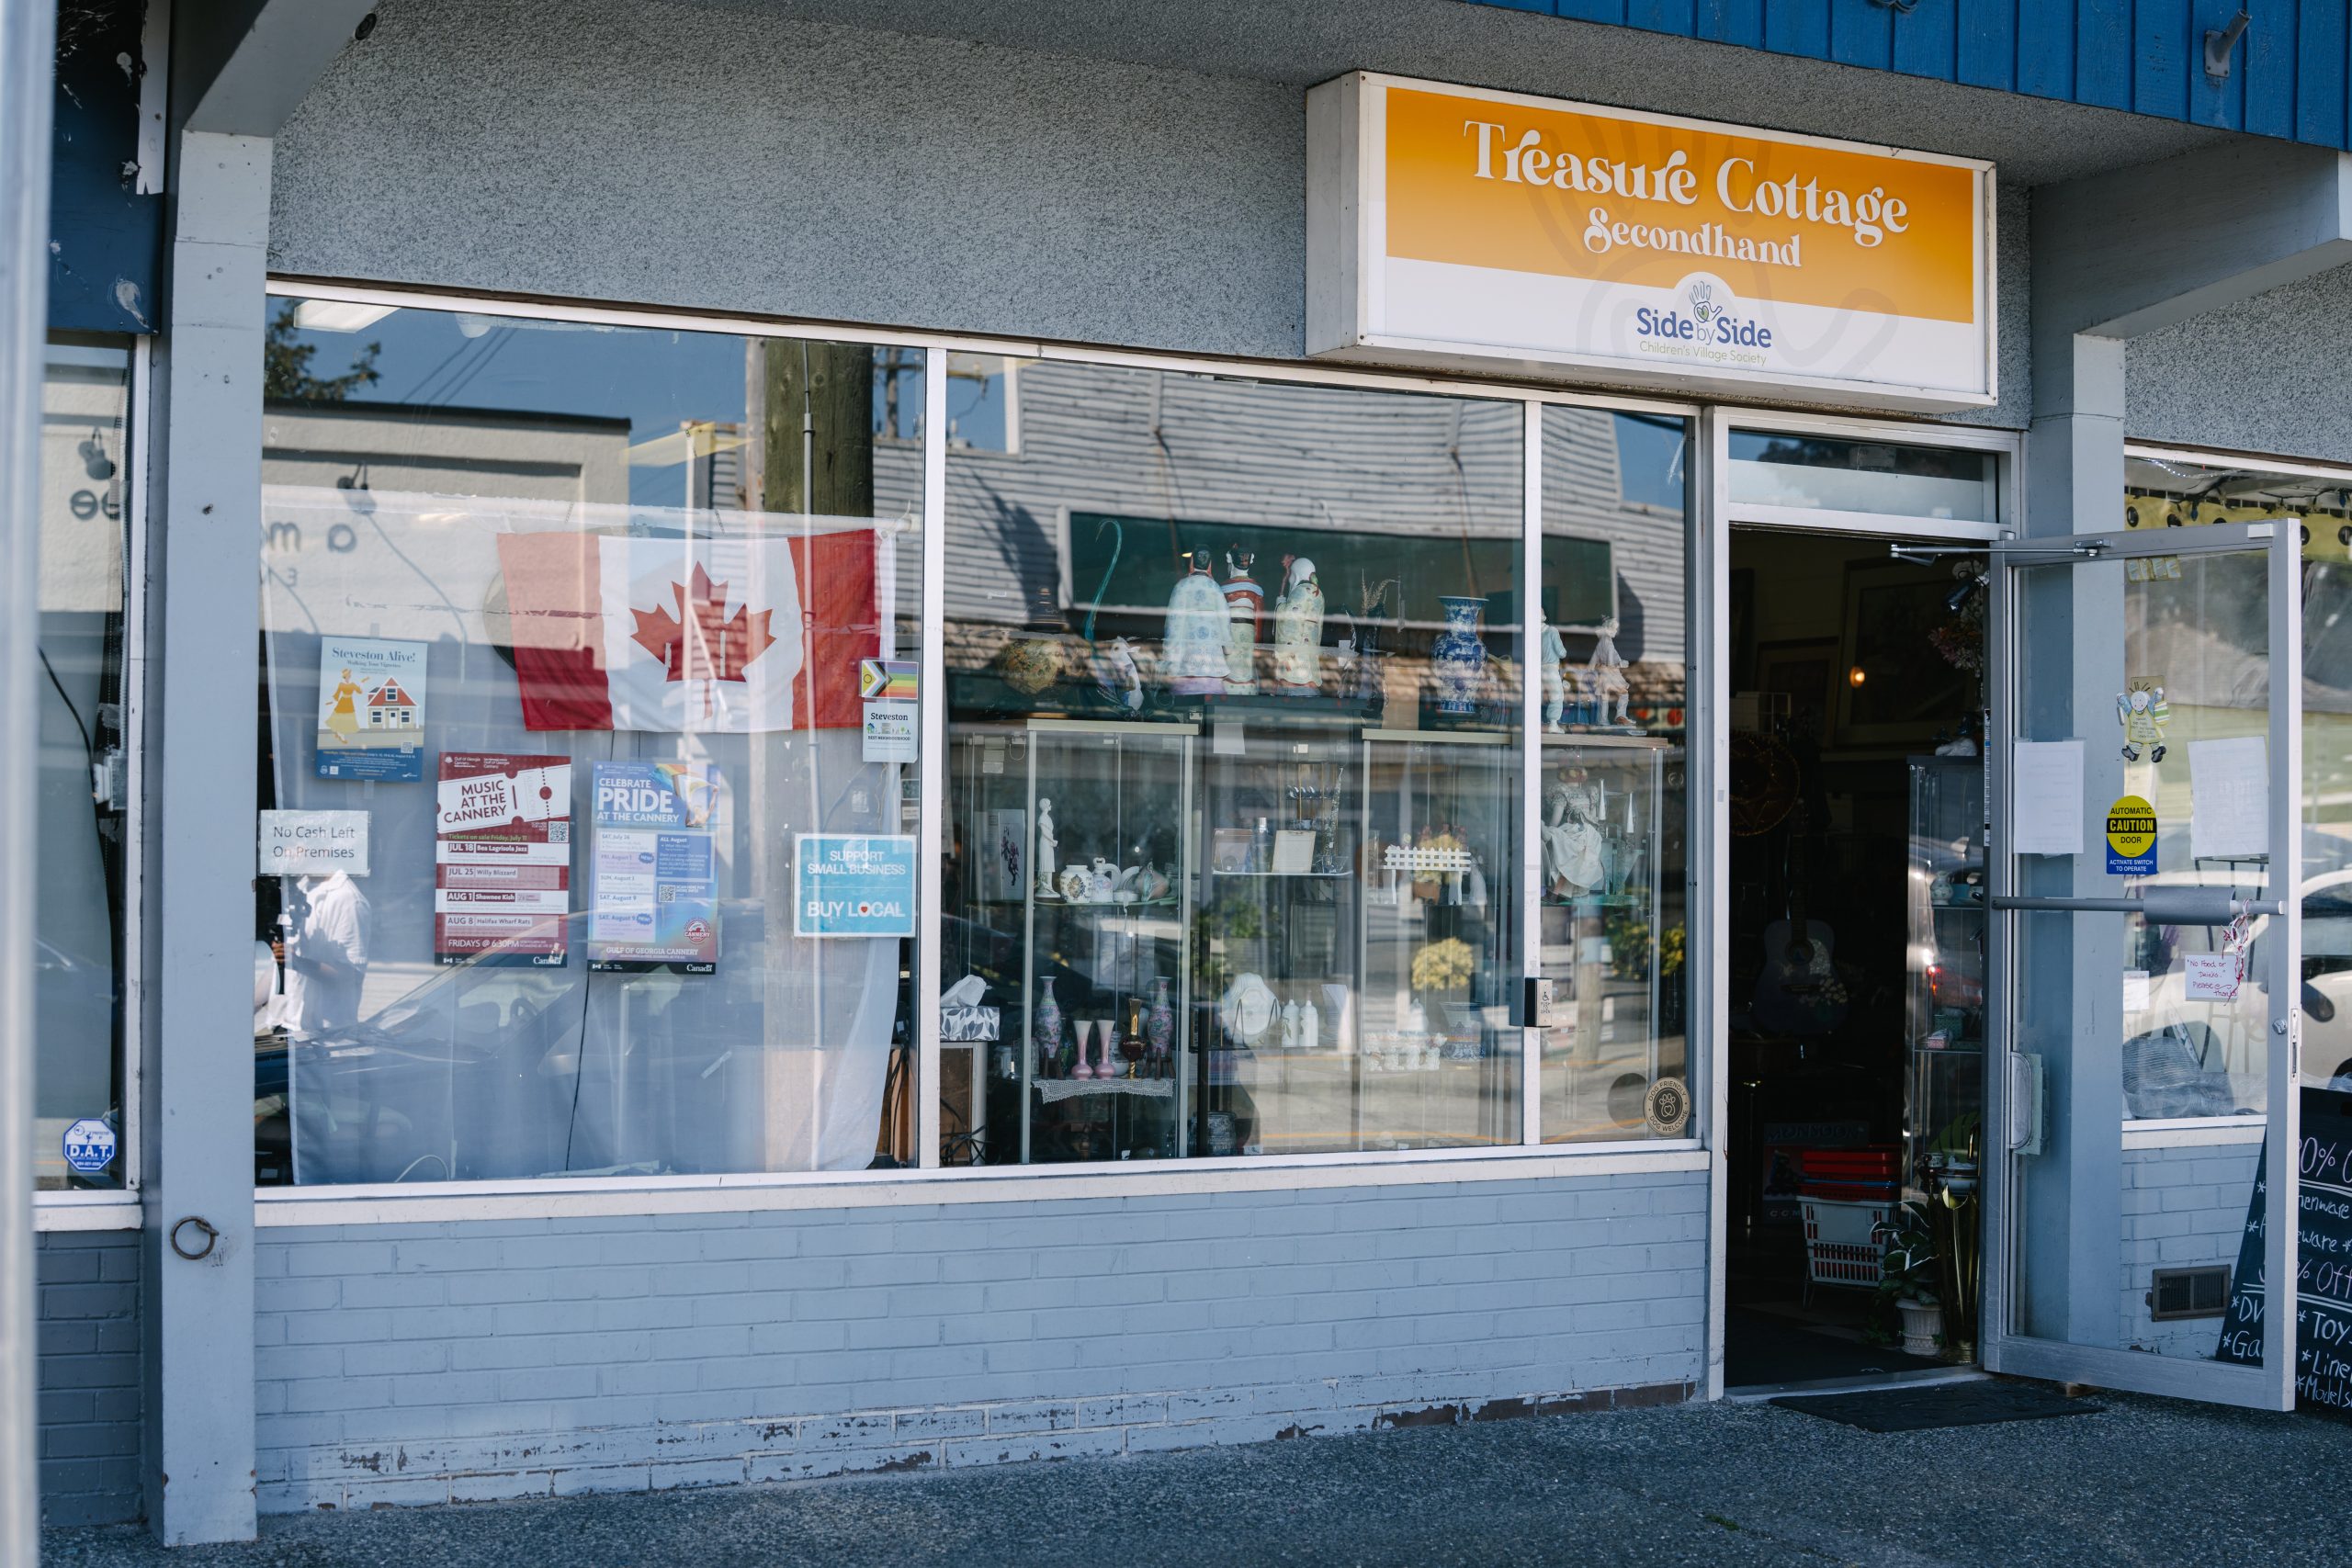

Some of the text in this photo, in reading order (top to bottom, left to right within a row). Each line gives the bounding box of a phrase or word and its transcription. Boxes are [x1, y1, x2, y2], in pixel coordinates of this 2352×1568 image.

[1464, 120, 1909, 247] Treasure Cottage
[1583, 208, 1802, 267] Secondhand
[1636, 307, 1772, 348] Side by Side
[1639, 340, 1767, 367] Children's Village Society
[332, 646, 416, 662] Steveston Alive!
[870, 712, 909, 721] Steveston
[461, 780, 504, 796] MUSIC
[599, 778, 651, 788] CELEBRATE
[461, 793, 506, 809] AT THE
[598, 787, 673, 814] PRIDE
[444, 805, 507, 823] CANNERY
[597, 812, 680, 823] AT THE CANNERY
[273, 826, 355, 838] No Cash Left
[2109, 819, 2154, 832] CAUTION
[273, 846, 355, 858] On Premises
[449, 844, 464, 852] JUL
[830, 850, 884, 862] SUPPORT
[807, 863, 906, 875] SMALL BUSINESS
[447, 893, 467, 901] AUG
[808, 901, 905, 918] BUY LOCAL
[448, 939, 481, 948] FRIDAYS
[482, 939, 490, 948] @
[686, 964, 712, 972] Canada
[1648, 1081, 1686, 1101] DOG FRIENDLY
[1650, 1110, 1688, 1131] DOG WELCOME
[1765, 1122, 1860, 1143] MONSOON
[70, 1144, 110, 1157] D.A.T.
[2299, 1136, 2337, 1178] 0%
[2312, 1310, 2352, 1346] Toy
[2312, 1349, 2352, 1382] Line
